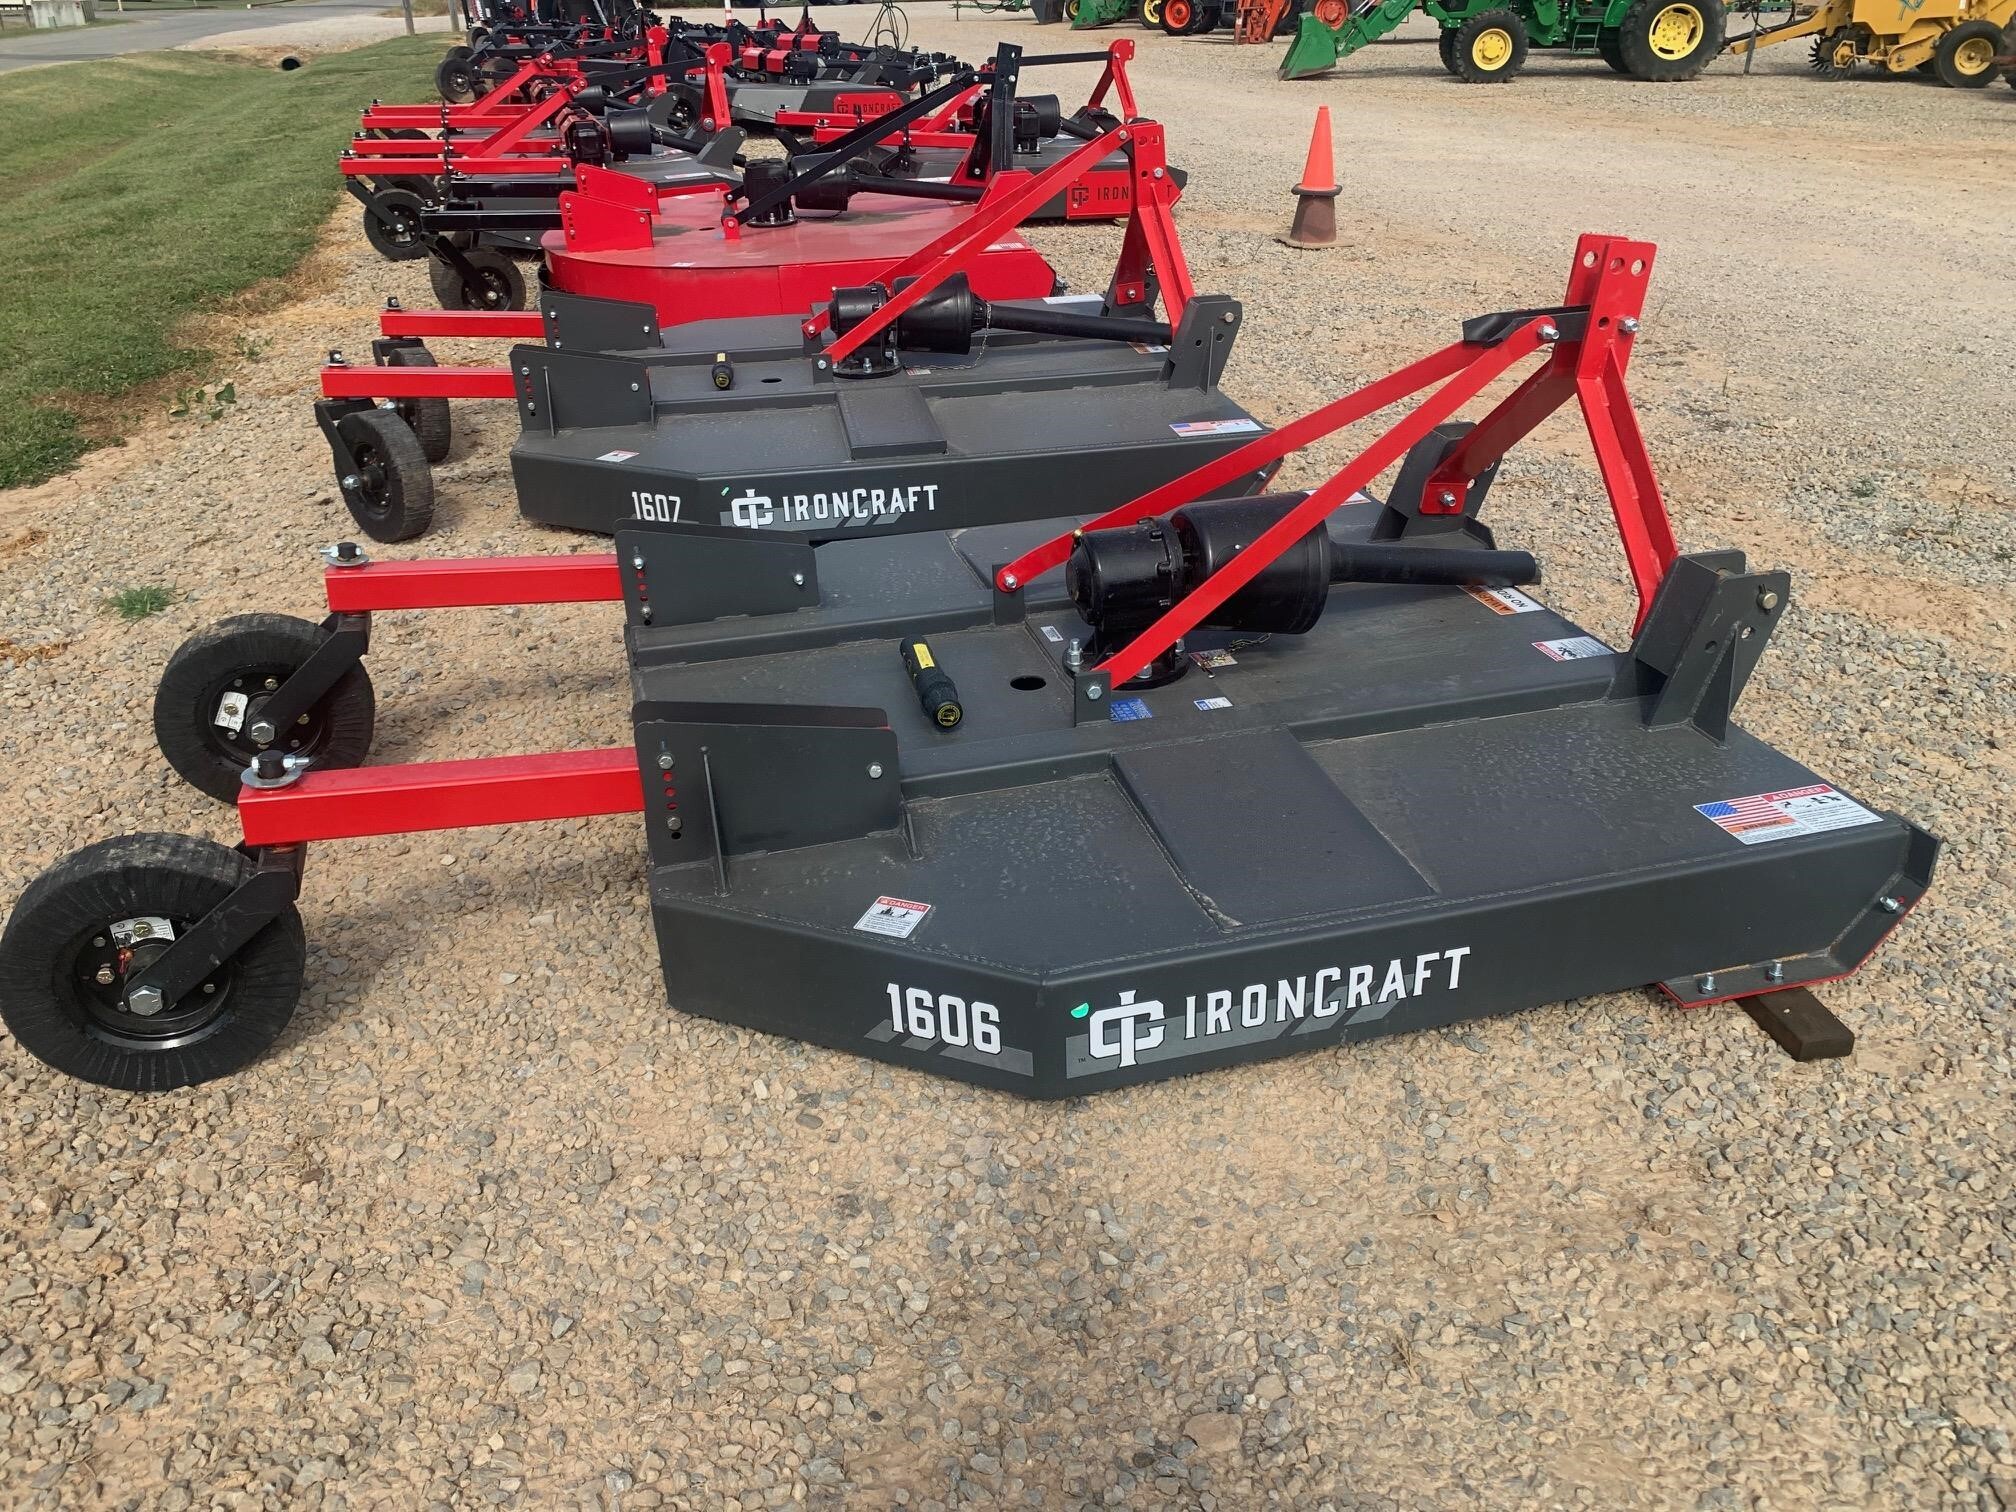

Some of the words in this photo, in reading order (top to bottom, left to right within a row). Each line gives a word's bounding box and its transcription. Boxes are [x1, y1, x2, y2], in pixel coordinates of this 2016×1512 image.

[1097, 185, 1172, 201] IRONT
[631, 491, 681, 523] 1607
[782, 484, 939, 523] IRONCRAFT
[1780, 787, 1824, 800] DANGER
[889, 900, 925, 911] DANGER
[1183, 946, 1472, 1040] IRONCRAFT
[886, 982, 1001, 1055] 1606
